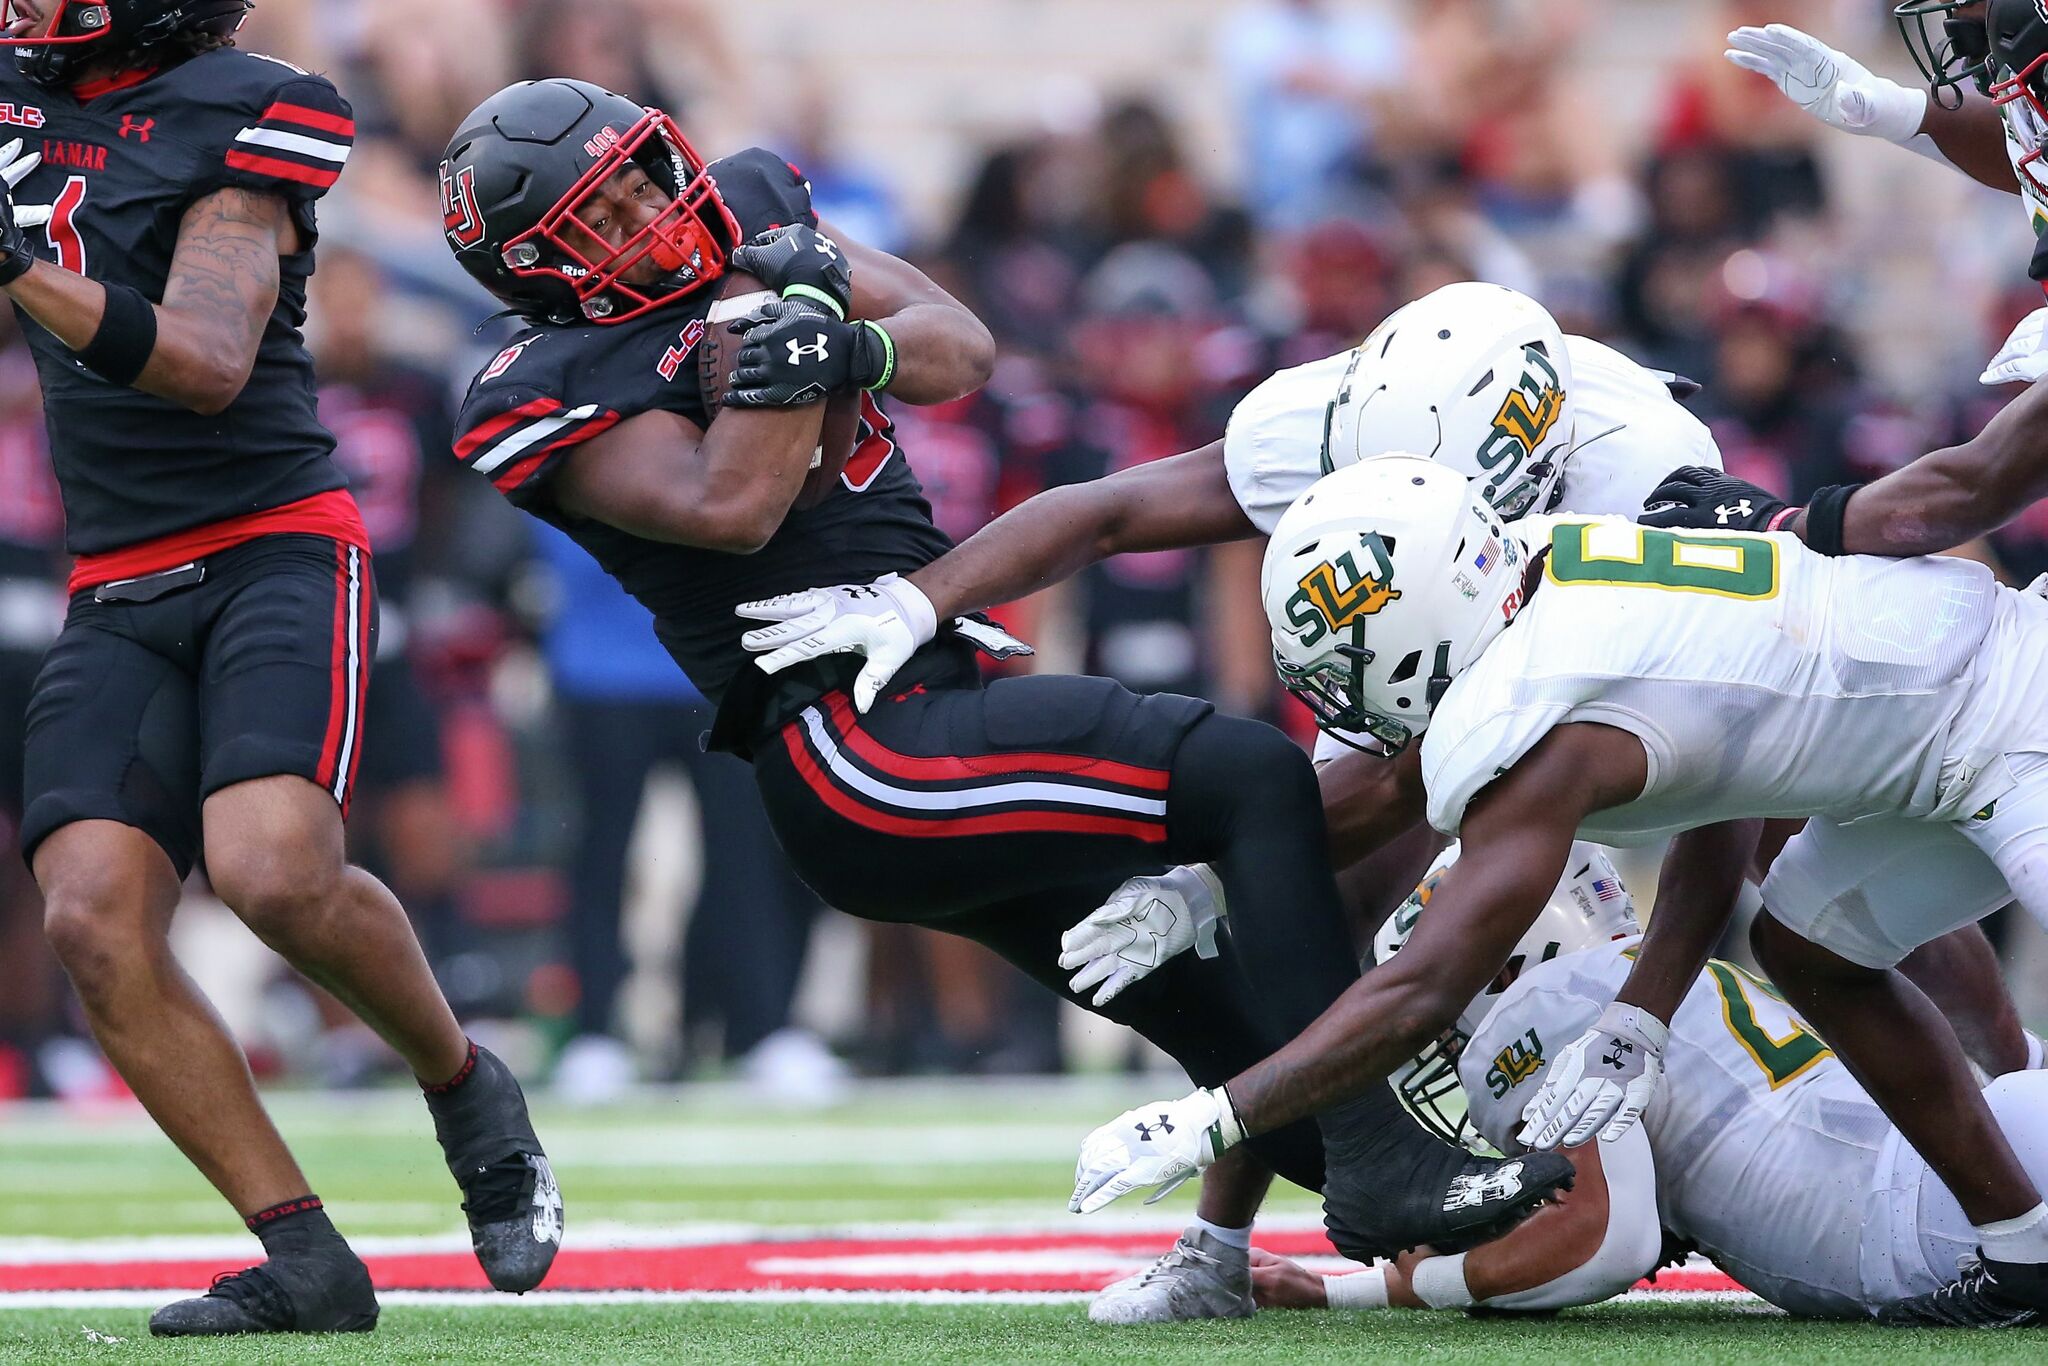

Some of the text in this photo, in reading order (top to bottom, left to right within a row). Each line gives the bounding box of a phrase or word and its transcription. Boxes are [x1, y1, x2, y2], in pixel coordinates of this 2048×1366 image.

[42, 140, 108, 170] LAMAR
[583, 126, 620, 157] 409
[46, 175, 86, 277] 1
[656, 318, 705, 382] SLC
[1476, 345, 1567, 487] SLU
[1472, 505, 1488, 524] 6
[1285, 530, 1402, 648] SLU
[1544, 522, 1780, 602] 6
[1485, 1026, 1546, 1100] SLU
